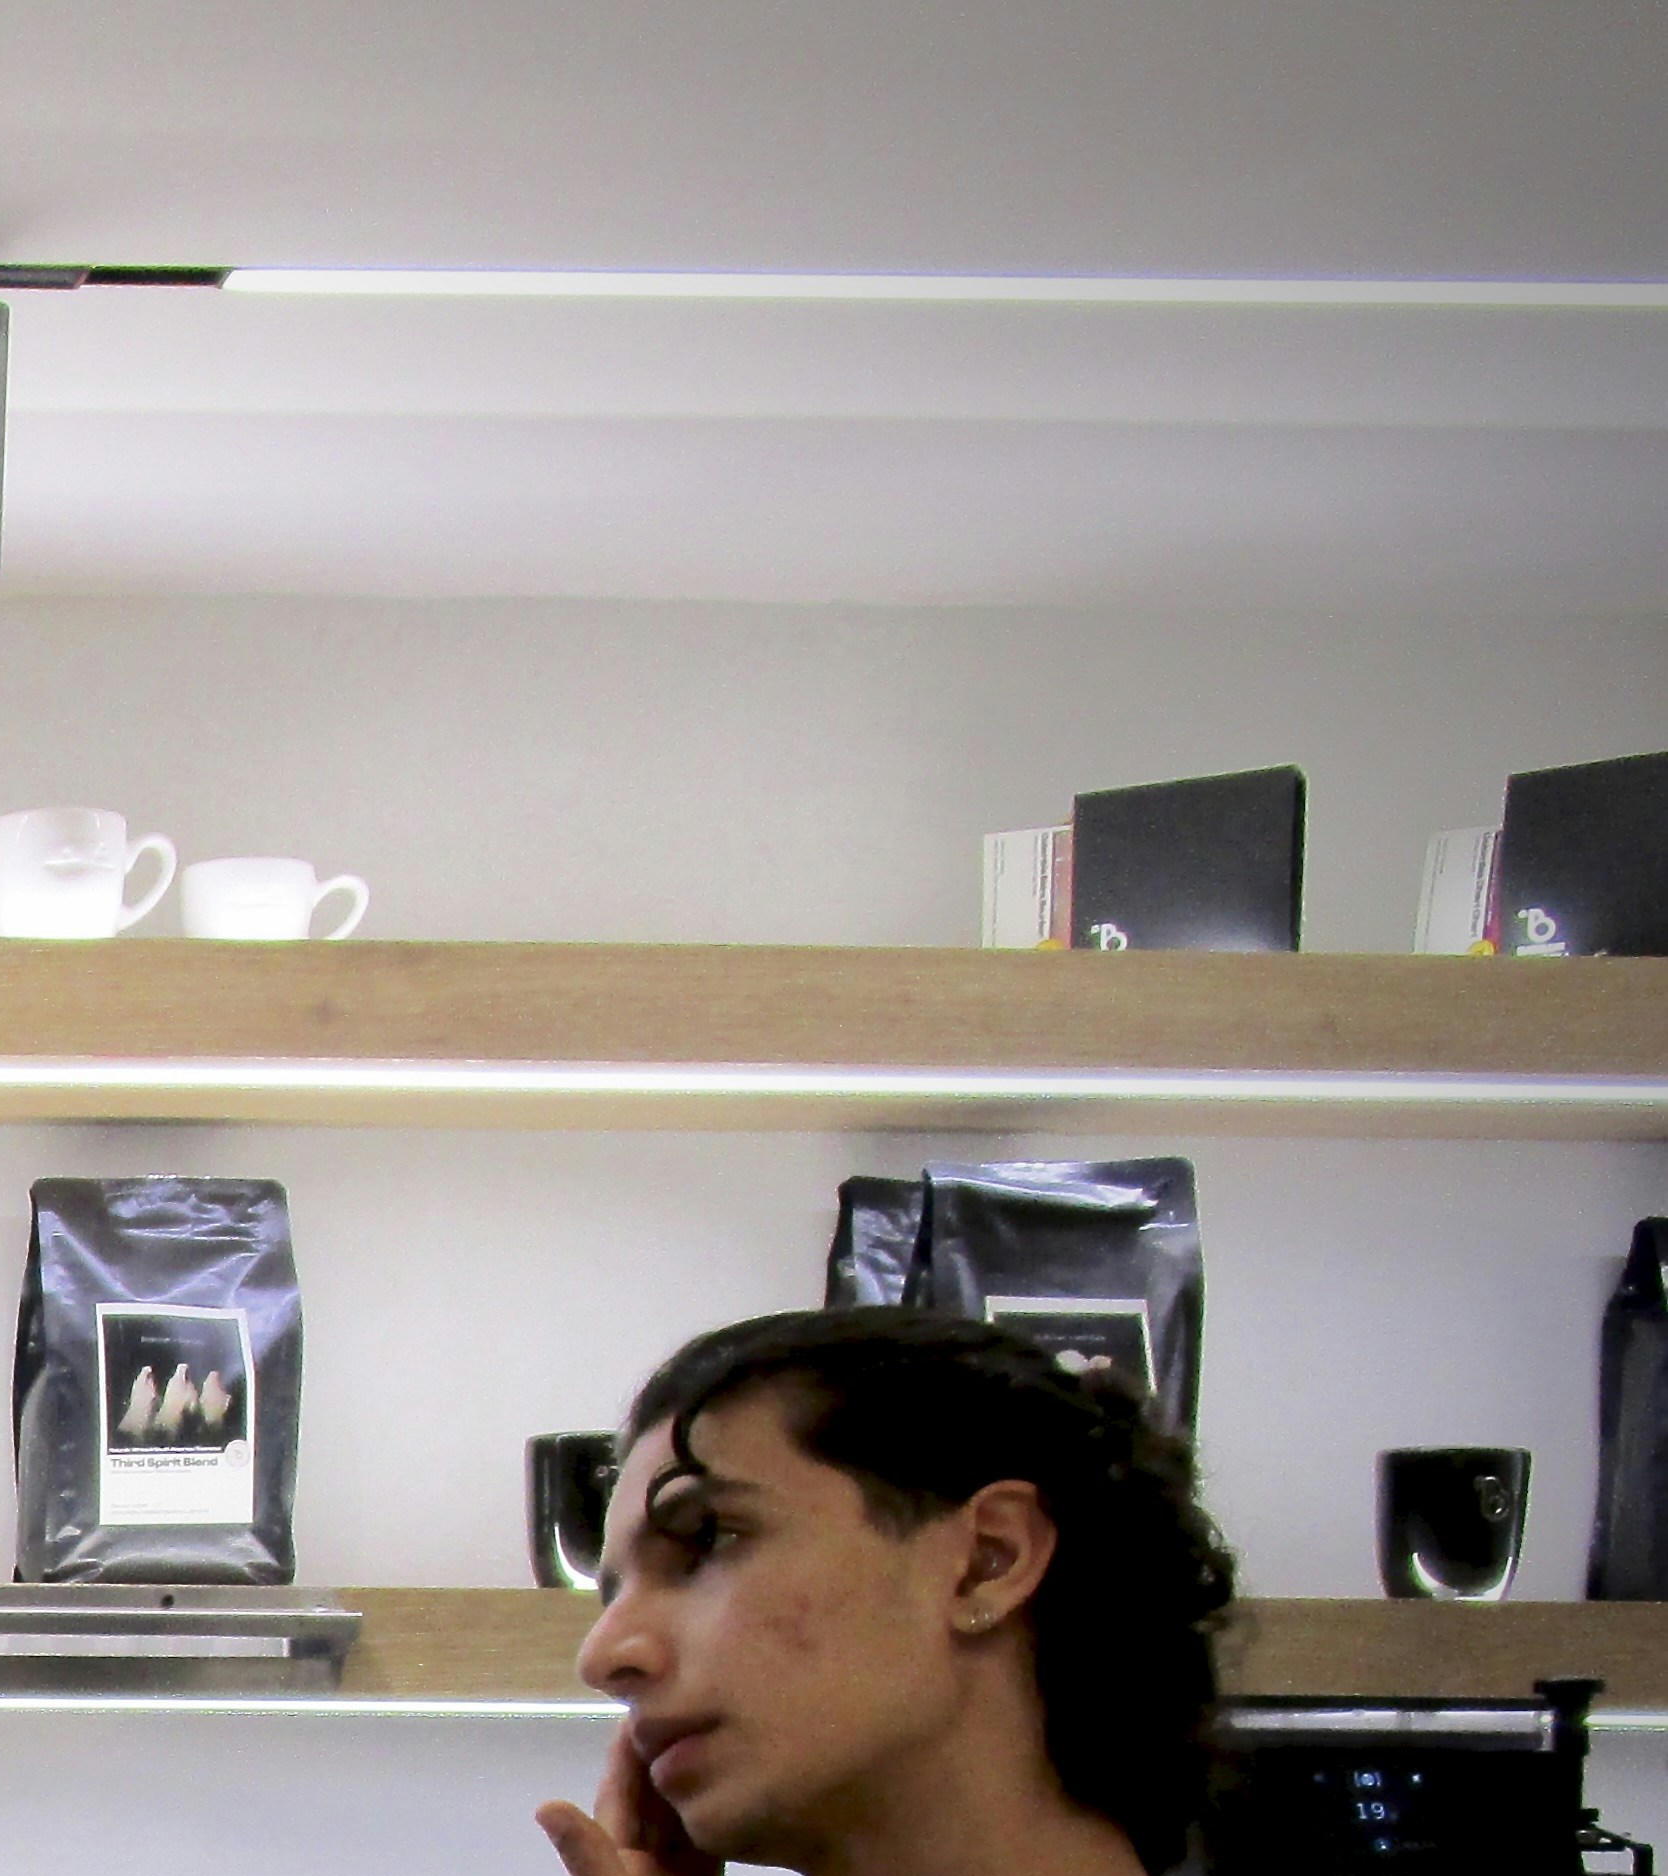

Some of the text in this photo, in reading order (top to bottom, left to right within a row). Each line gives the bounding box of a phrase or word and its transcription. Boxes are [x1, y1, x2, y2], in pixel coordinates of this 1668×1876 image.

[111, 1457, 218, 1469] Third Spirit Blend
[1356, 1802, 1385, 1820] 19
